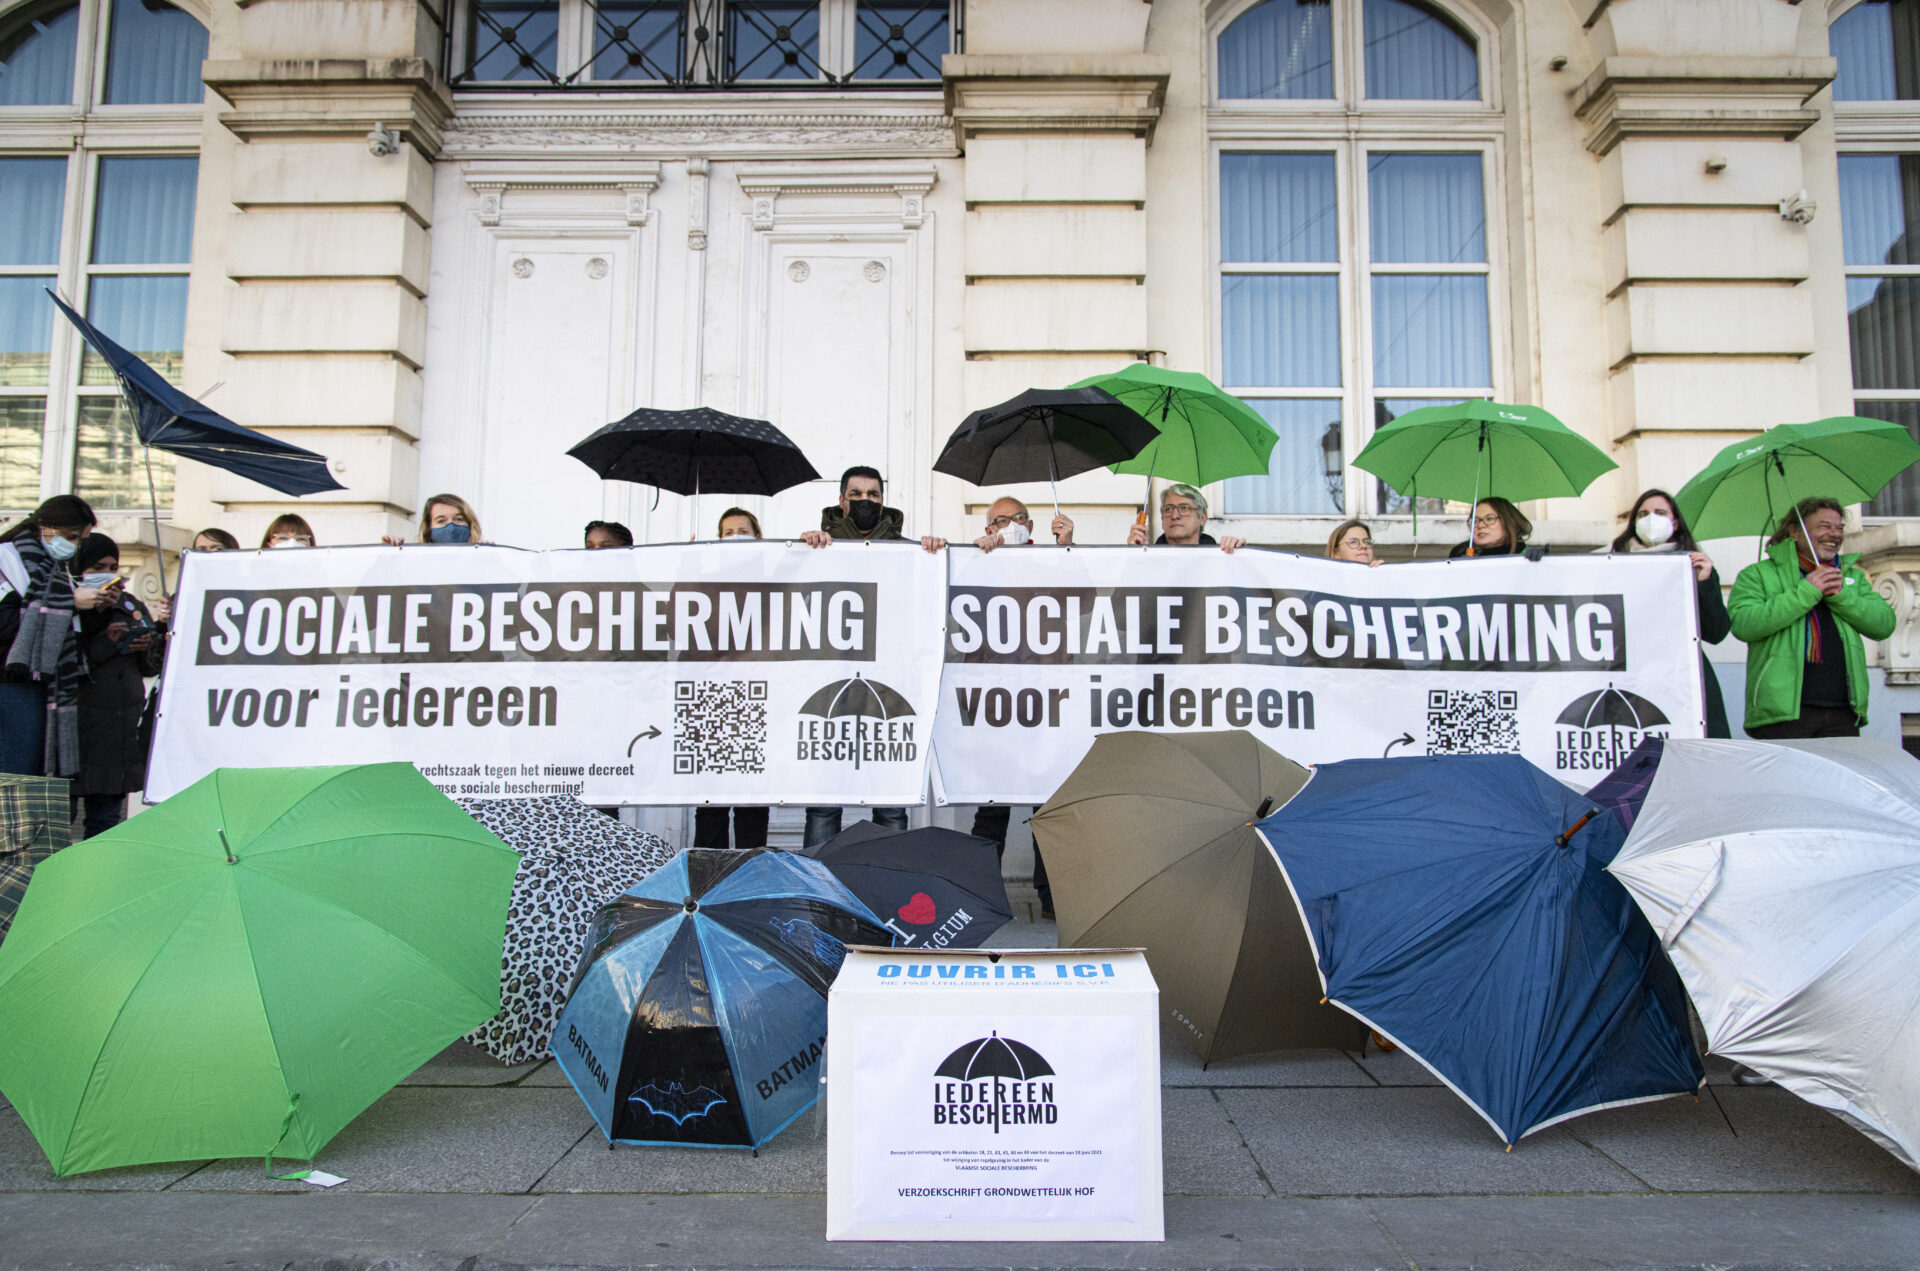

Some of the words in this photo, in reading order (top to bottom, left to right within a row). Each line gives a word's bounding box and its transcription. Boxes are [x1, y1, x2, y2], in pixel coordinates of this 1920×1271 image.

[210, 593, 432, 656] SOCIALE
[450, 590, 864, 653] BESCHERMING
[950, 593, 1183, 655] SOCIALE
[1204, 595, 1615, 662] BESCHERMING
[207, 688, 319, 728] voor
[335, 672, 557, 728] iedereen
[955, 687, 1070, 728] voor
[1090, 673, 1315, 730] iedereen
[798, 720, 915, 741] IEDEREEN
[796, 740, 917, 762] BESCHERMD
[420, 763, 481, 776] rechtszaak
[485, 764, 517, 779] tegen
[520, 763, 540, 776] het
[543, 763, 585, 776] nieuwe
[588, 763, 635, 776] decreet
[460, 781, 501, 794] sociale
[504, 780, 585, 796] bescherming!
[884, 917, 917, 946] I
[920, 908, 974, 950] LGIUM
[877, 964, 1036, 979] OUVRIR
[1055, 963, 1115, 978] ICI
[567, 1023, 609, 1094] BATMAN
[935, 1083, 1053, 1103] IEDEREEN
[934, 1104, 1058, 1124] BESCHERMD
[898, 1187, 982, 1197] VERZOEKSCHRIFT
[984, 1187, 1072, 1197] GRONDWETTELIJK
[1075, 1187, 1095, 1196] HOF
